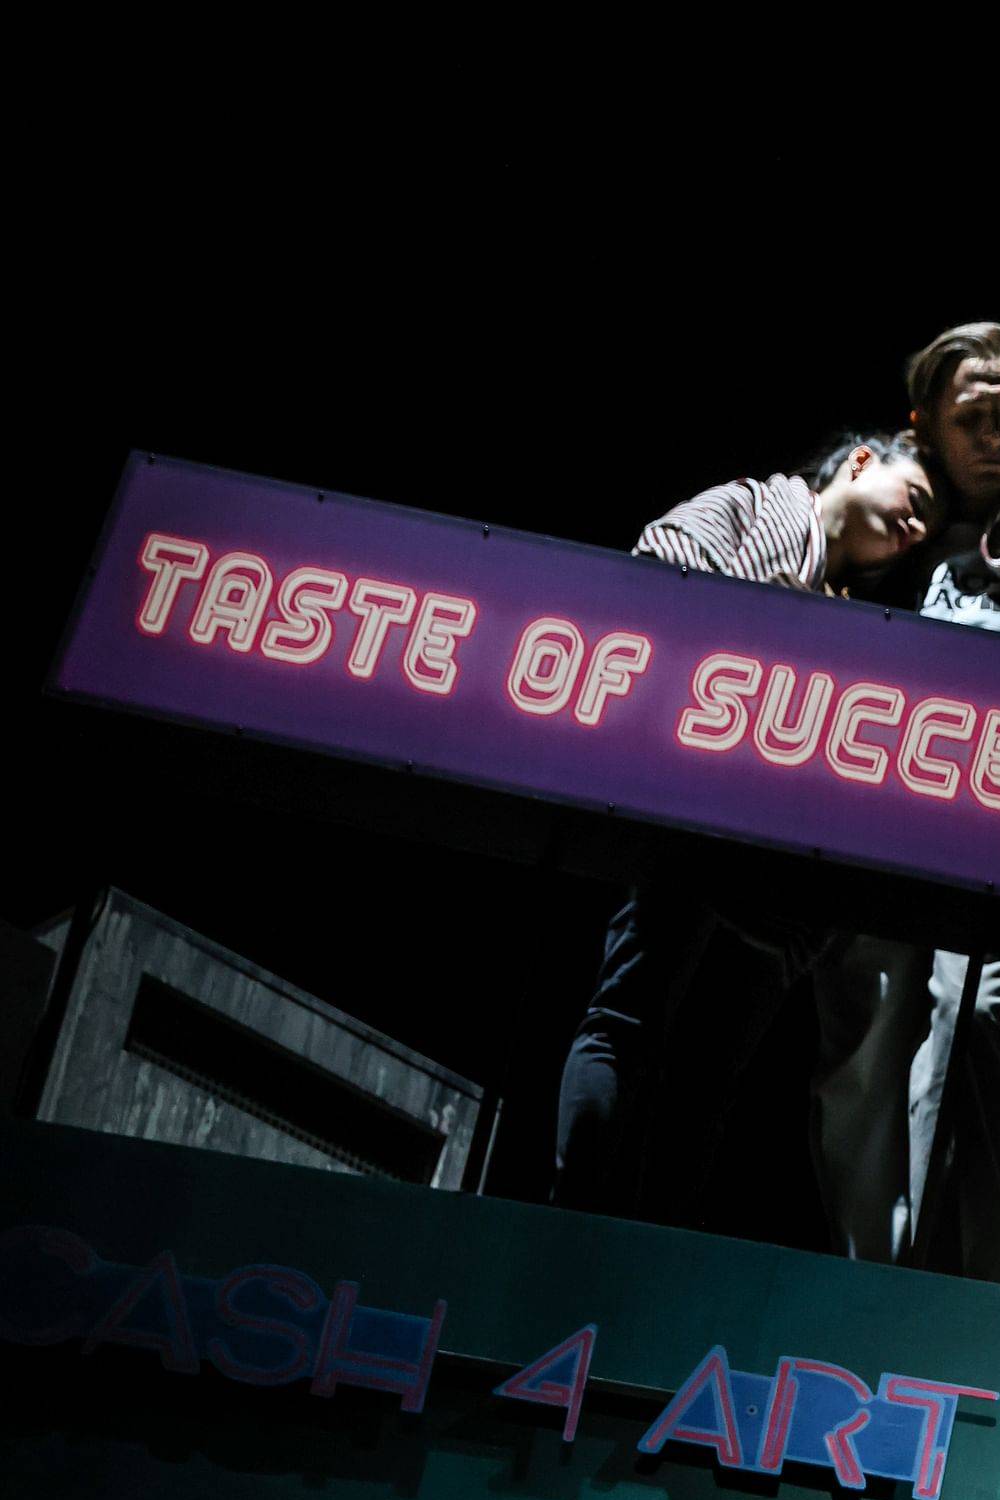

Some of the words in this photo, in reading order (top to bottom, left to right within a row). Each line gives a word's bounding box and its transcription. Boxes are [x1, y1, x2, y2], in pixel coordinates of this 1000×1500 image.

[139, 533, 477, 695] TASTE
[509, 617, 652, 726] OF
[493, 1323, 598, 1443] 4
